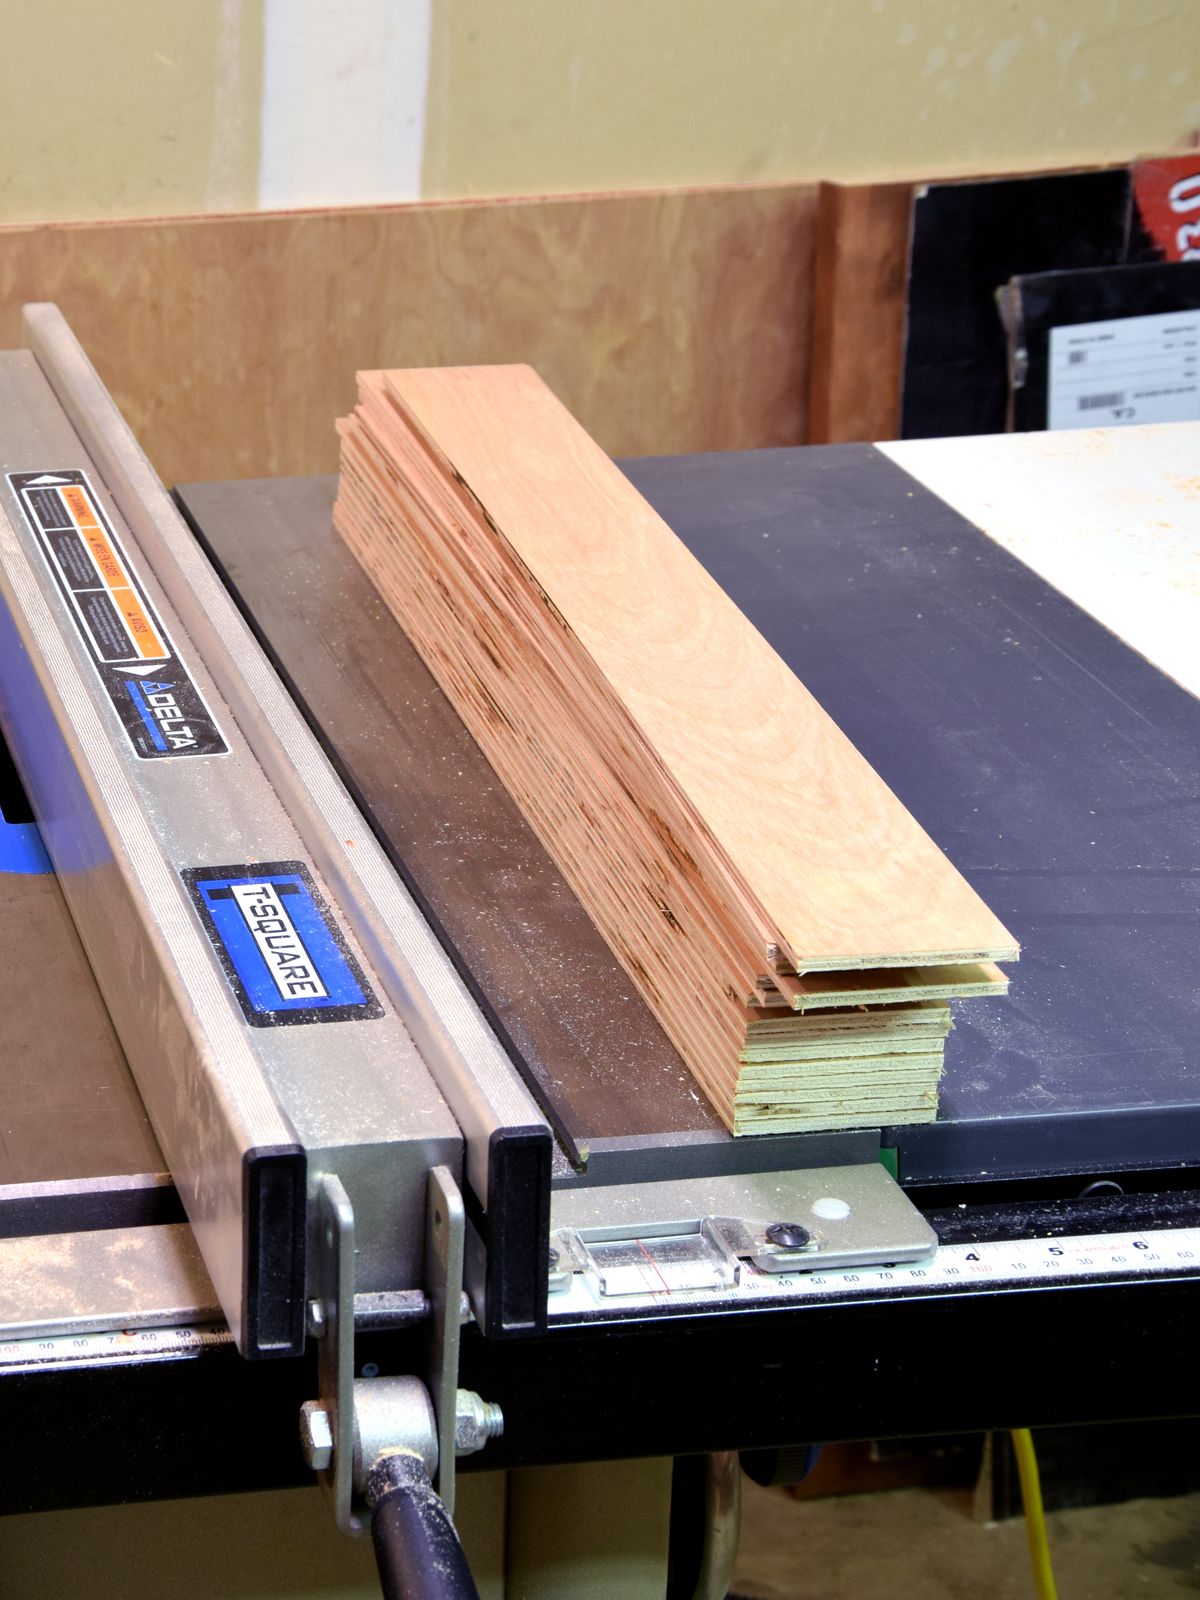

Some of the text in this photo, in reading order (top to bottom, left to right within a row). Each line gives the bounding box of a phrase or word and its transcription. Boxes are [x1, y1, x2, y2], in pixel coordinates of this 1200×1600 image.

[131, 616, 148, 632] AVISO
[147, 693, 198, 750] DELTA
[243, 886, 319, 997] T-SQUARE
[965, 1252, 980, 1262] 4
[1048, 1246, 1064, 1256] 5
[1132, 1241, 1149, 1251] 6
[778, 1279, 793, 1287] 40
[810, 1277, 826, 1285] 50
[844, 1274, 860, 1283] 60
[878, 1272, 893, 1281] 70
[910, 1269, 926, 1278] 80
[970, 1264, 993, 1274] 100
[1011, 1262, 1027, 1271] 10
[1043, 1260, 1060, 1269] 20
[1076, 1257, 1094, 1266] 30
[1110, 1254, 1127, 1264] 40
[1143, 1252, 1160, 1262] 50
[1176, 1250, 1194, 1259] 60
[176, 1330, 191, 1338] 50
